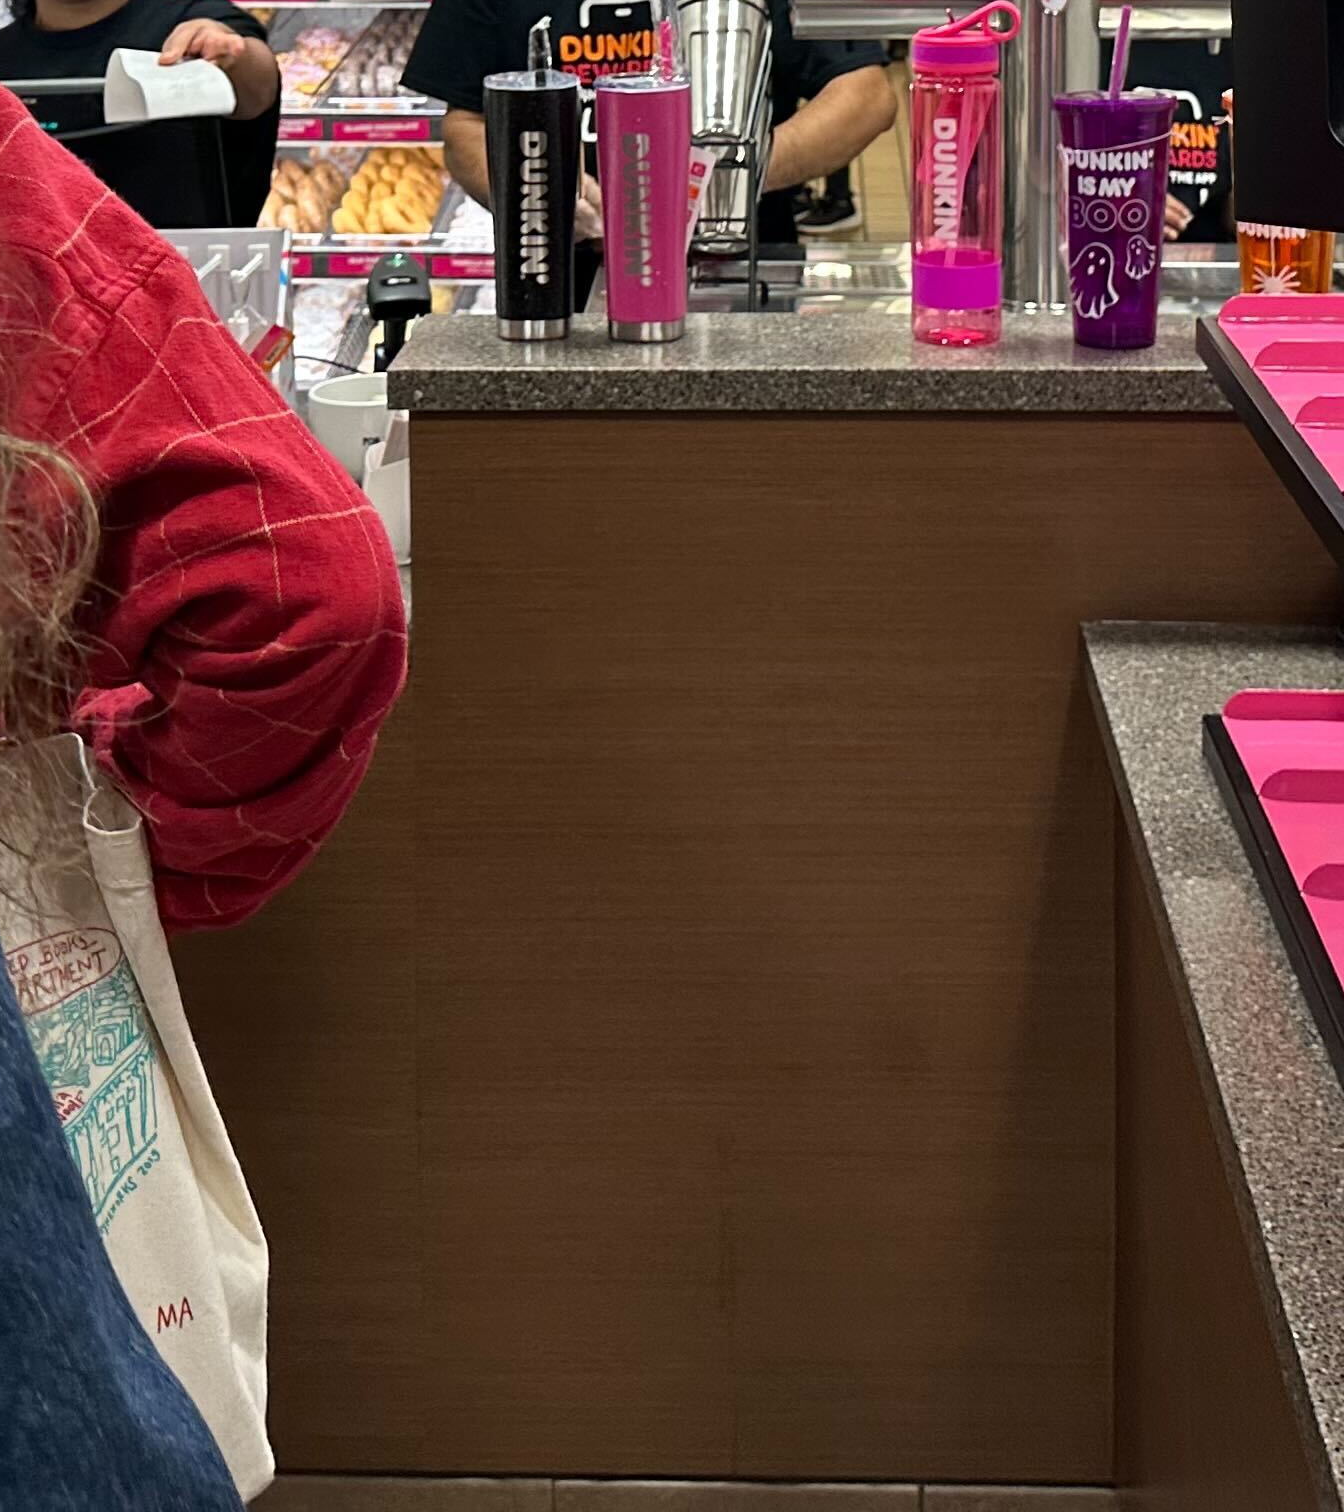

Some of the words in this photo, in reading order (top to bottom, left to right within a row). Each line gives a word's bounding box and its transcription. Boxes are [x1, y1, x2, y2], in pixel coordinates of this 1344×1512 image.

[1078, 177, 1096, 196] IS
[1099, 177, 1136, 198] MY
[1071, 198, 1150, 234] BOO
[157, 1296, 194, 1334] MA
